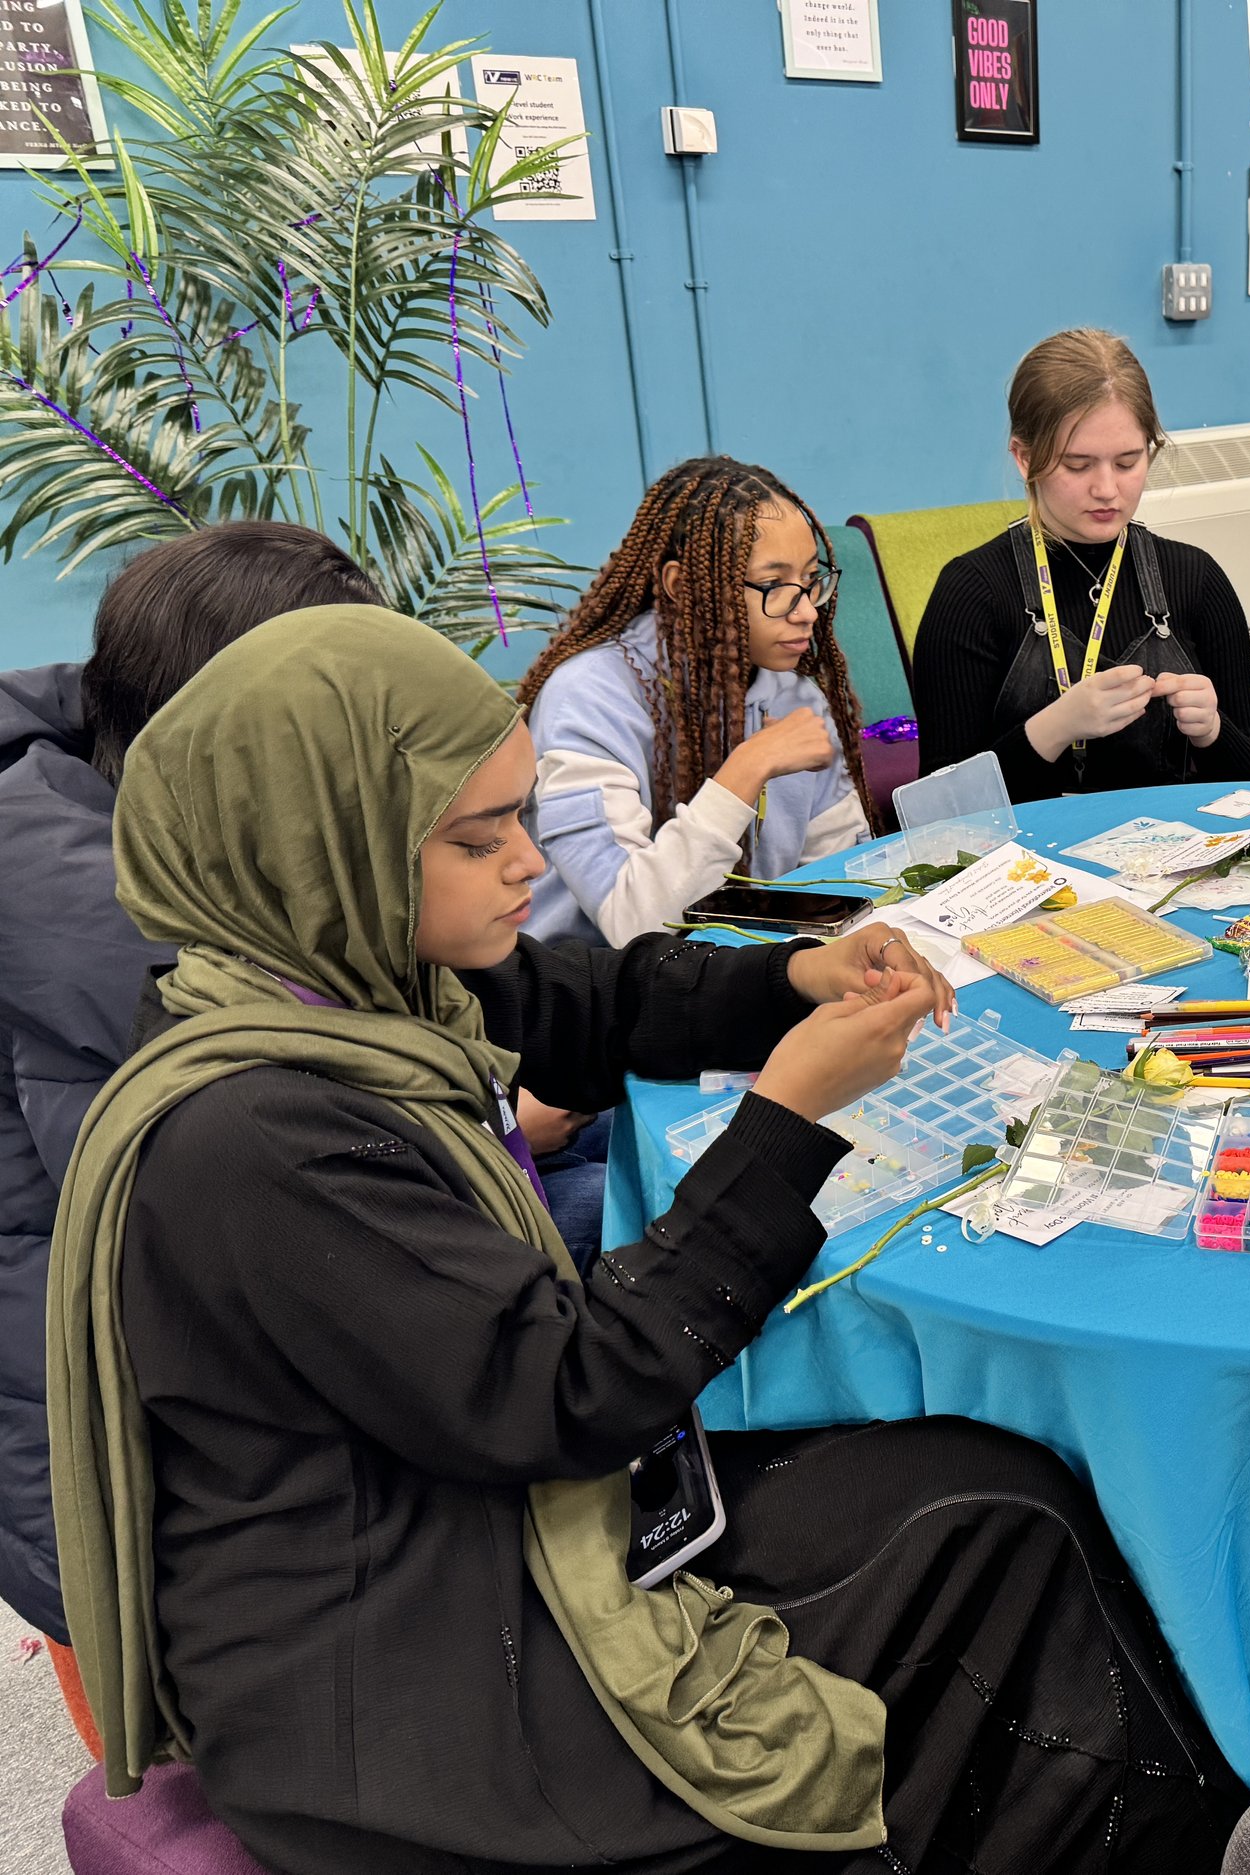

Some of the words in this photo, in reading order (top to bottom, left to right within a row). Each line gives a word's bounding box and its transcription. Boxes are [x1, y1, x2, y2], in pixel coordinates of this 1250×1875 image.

[0, 0, 35, 12] ING
[20, 21, 44, 33] TO
[806, 29, 821, 38] only
[823, 30, 842, 39] thing
[844, 31, 859, 39] that
[967, 17, 1009, 47] GOOD
[968, 49, 1012, 80] VIBES
[0, 81, 53, 93] BEING
[969, 80, 1009, 110] ONLY
[38, 102, 62, 112] TO
[1104, 564, 1118, 599] STUDENT
[1047, 612, 1060, 649] STUDENT
[1044, 1217, 1063, 1229] Day
[640, 1508, 692, 1550] 12:24
